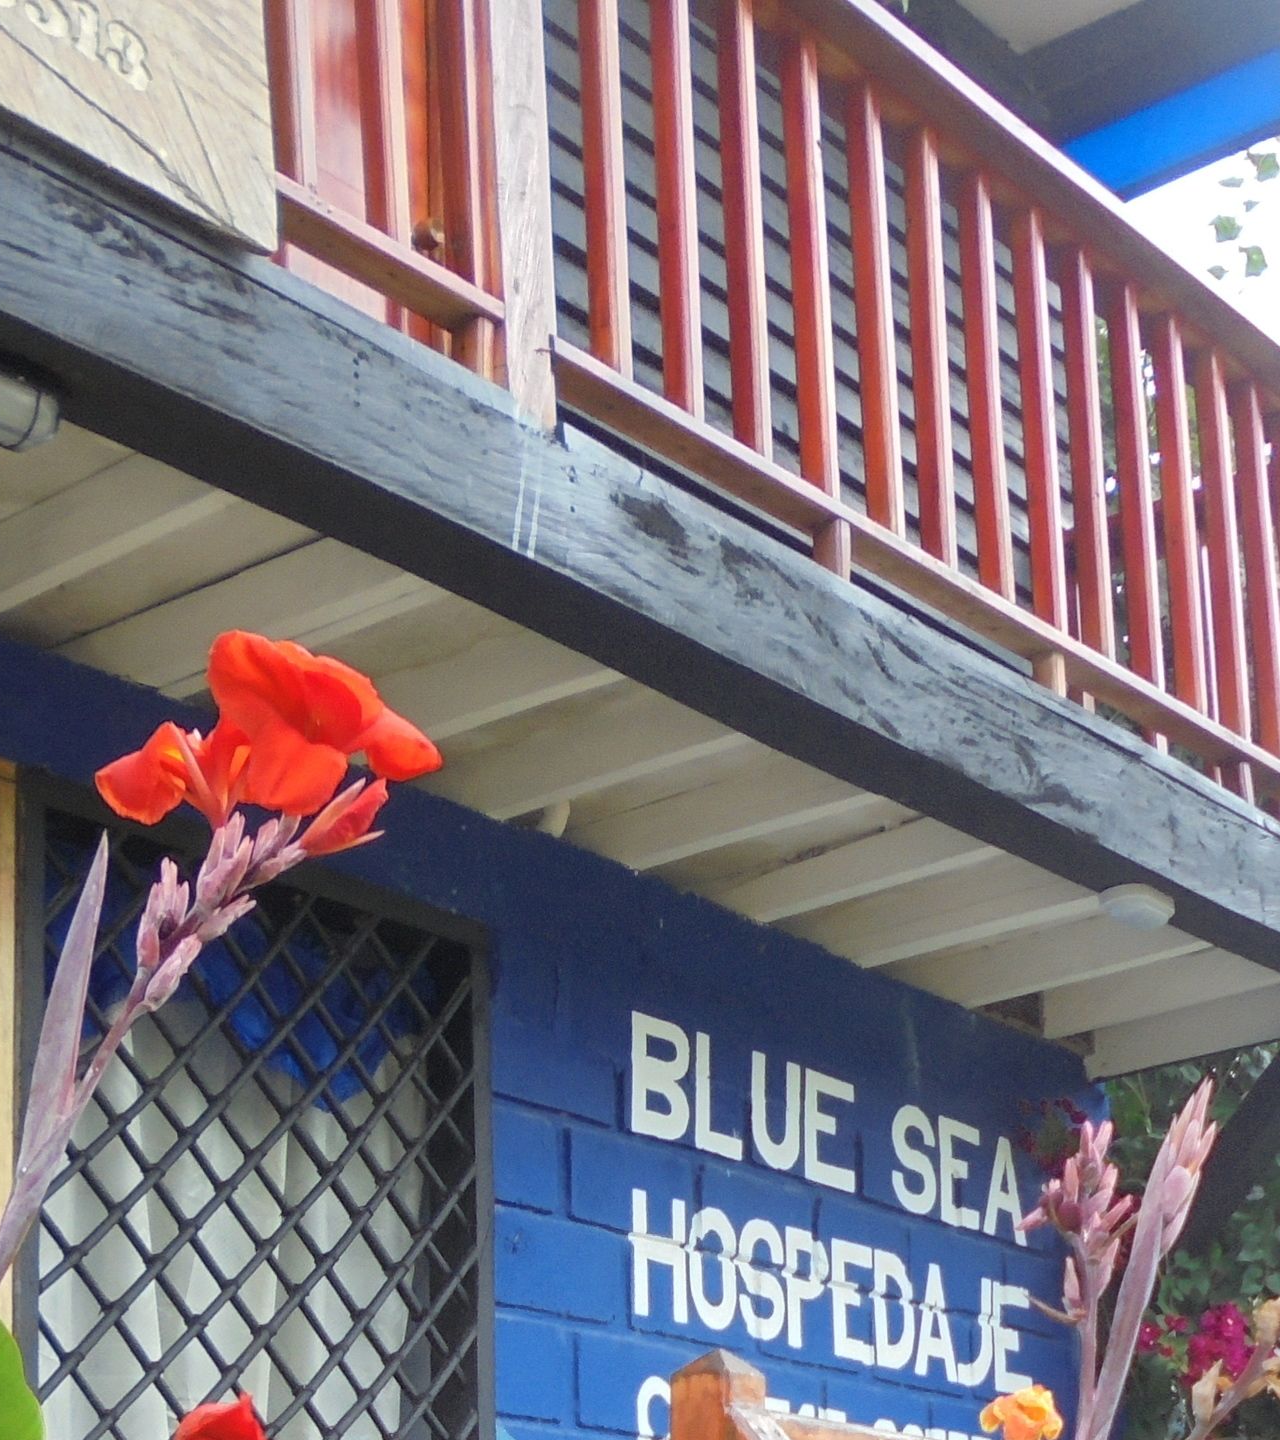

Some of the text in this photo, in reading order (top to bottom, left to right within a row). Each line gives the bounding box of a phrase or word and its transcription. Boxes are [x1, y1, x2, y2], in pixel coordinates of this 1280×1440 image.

[632, 1010, 1027, 1247] BLUE SEA
[628, 1189, 1033, 1394] HOSPEDAJE
